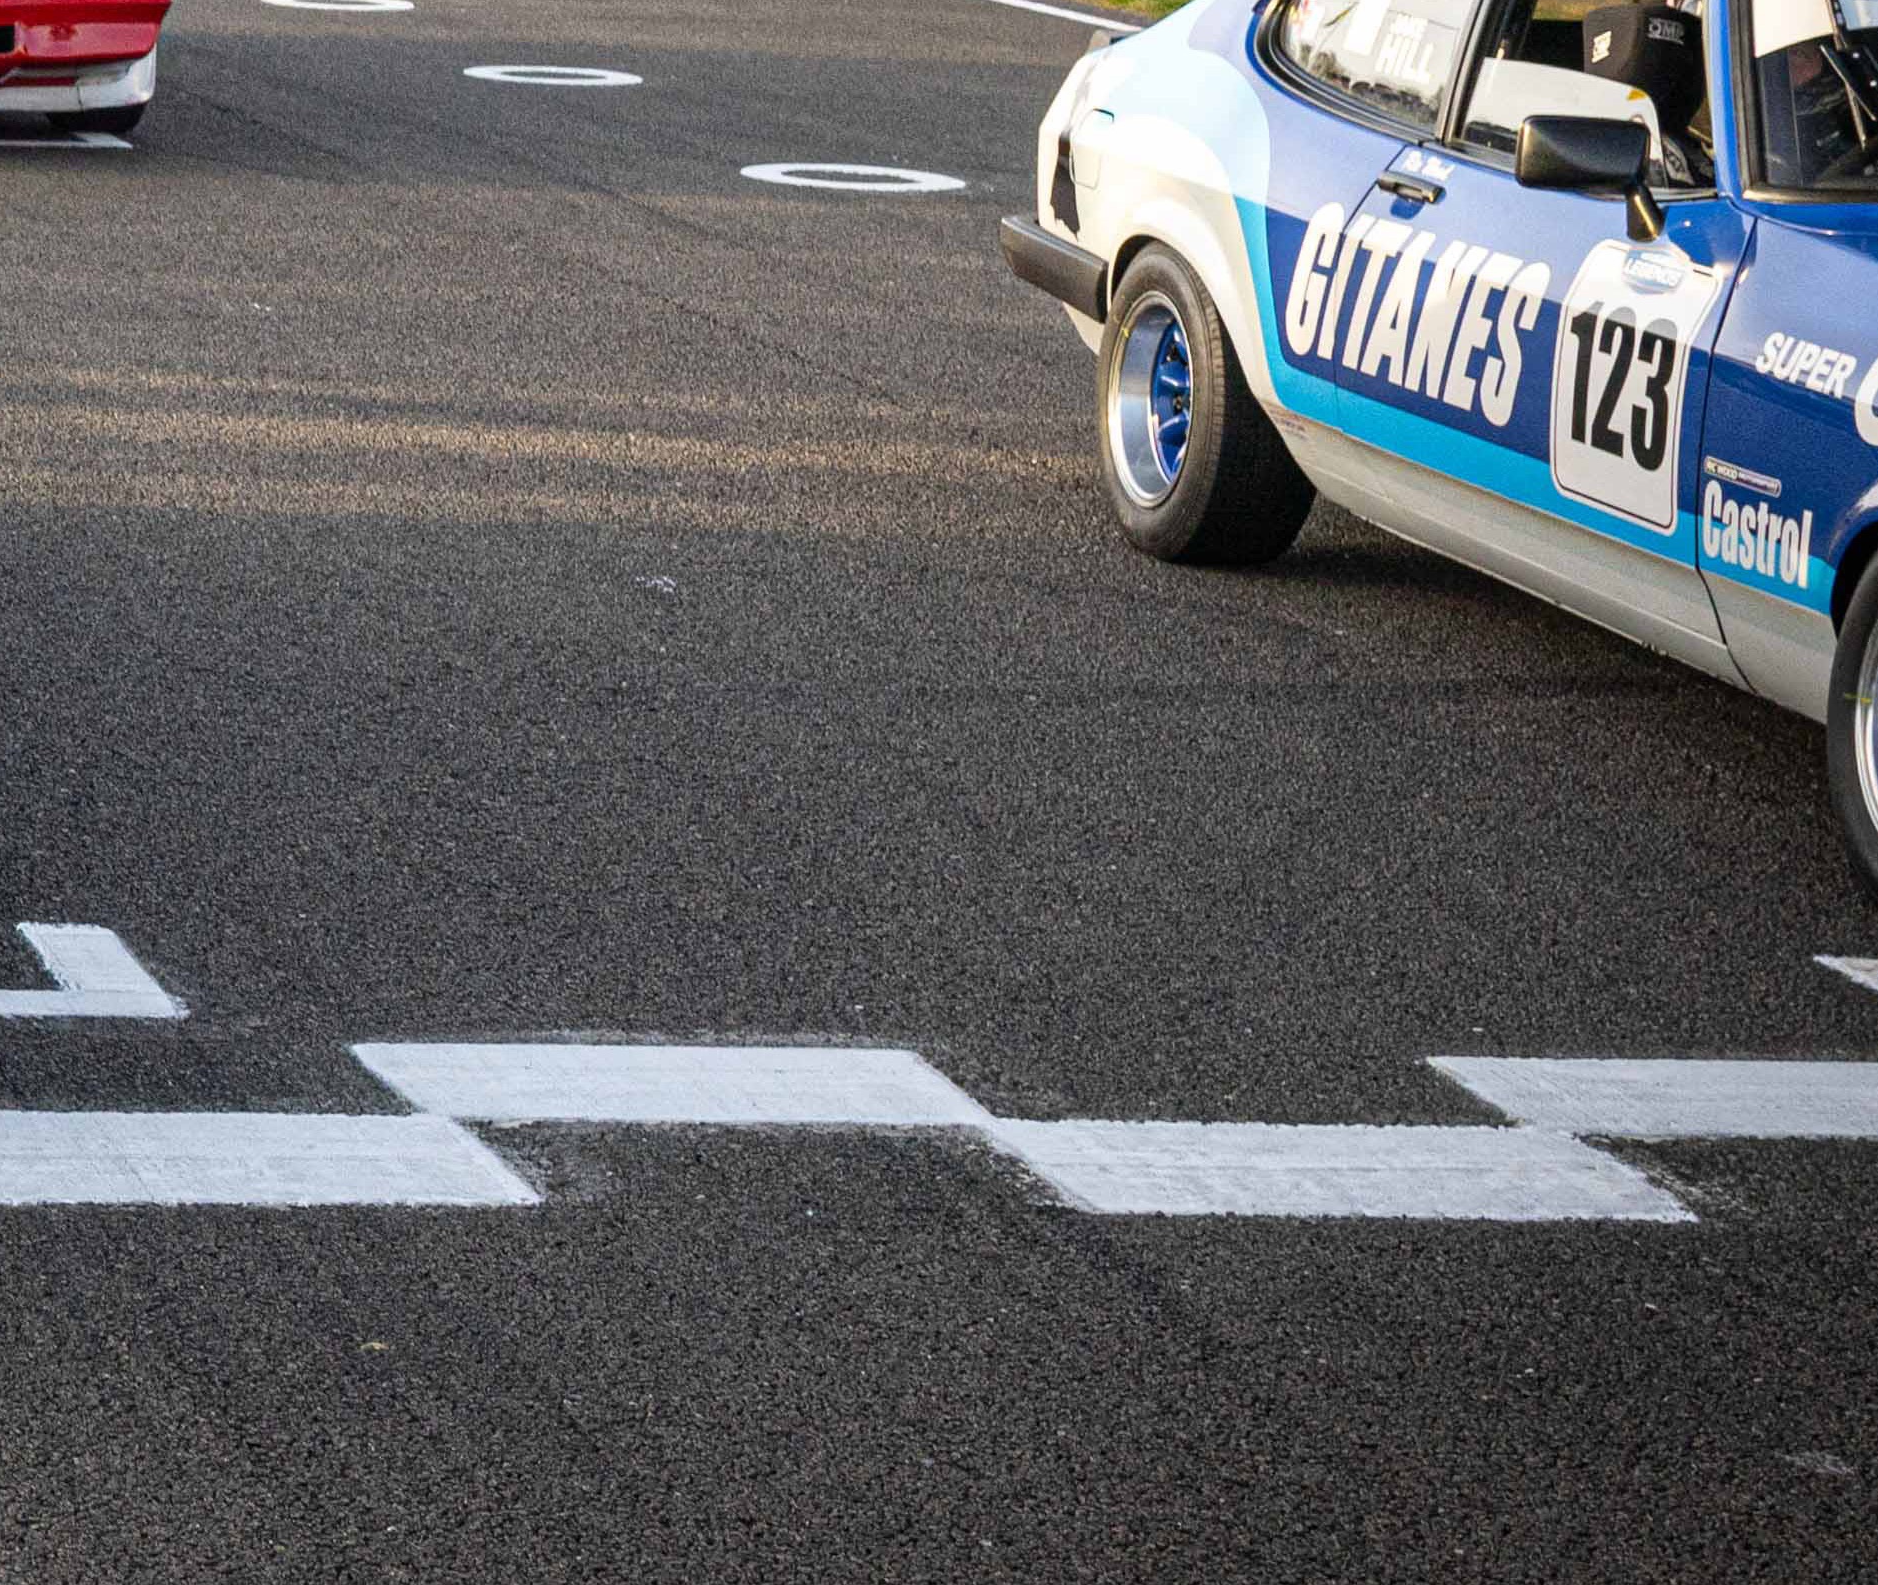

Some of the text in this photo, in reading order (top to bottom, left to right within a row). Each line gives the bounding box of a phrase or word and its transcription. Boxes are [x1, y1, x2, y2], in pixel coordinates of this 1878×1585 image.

[1374, 32, 1434, 85] HILL
[1283, 201, 1551, 428] GITANES
[1755, 331, 1858, 400] SUPER
[1569, 299, 1681, 473] 123
[1702, 479, 1814, 590] Castrol
